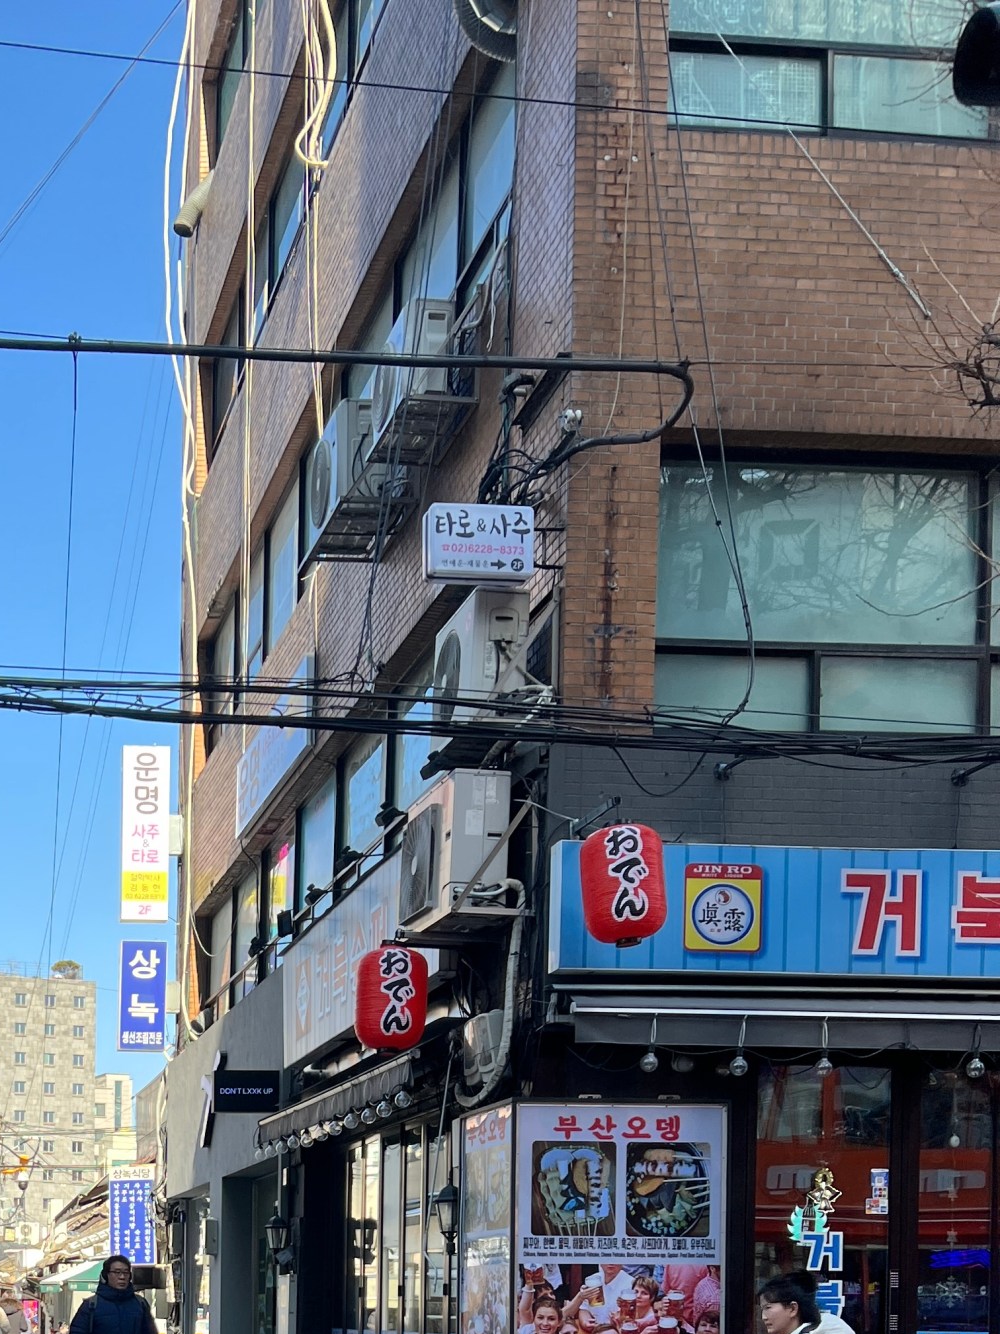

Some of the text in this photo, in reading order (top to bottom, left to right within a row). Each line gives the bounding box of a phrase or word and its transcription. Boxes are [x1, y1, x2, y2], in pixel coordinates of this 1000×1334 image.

[133, 753, 159, 814] 운명
[132, 824, 160, 840] 사주
[132, 849, 159, 864] 타로
[605, 826, 647, 920] おでん
[693, 865, 752, 874] JIN RO
[138, 905, 151, 915] 2F
[128, 950, 160, 1023] 상녹
[381, 949, 414, 1035] おでん
[122, 1030, 162, 1045] 생선조림전문
[242, 1087, 261, 1095] LXXK
[263, 1087, 273, 1095] UP
[553, 1115, 681, 1141] 부산오뎅
[113, 1168, 151, 1179] 상녹식당
